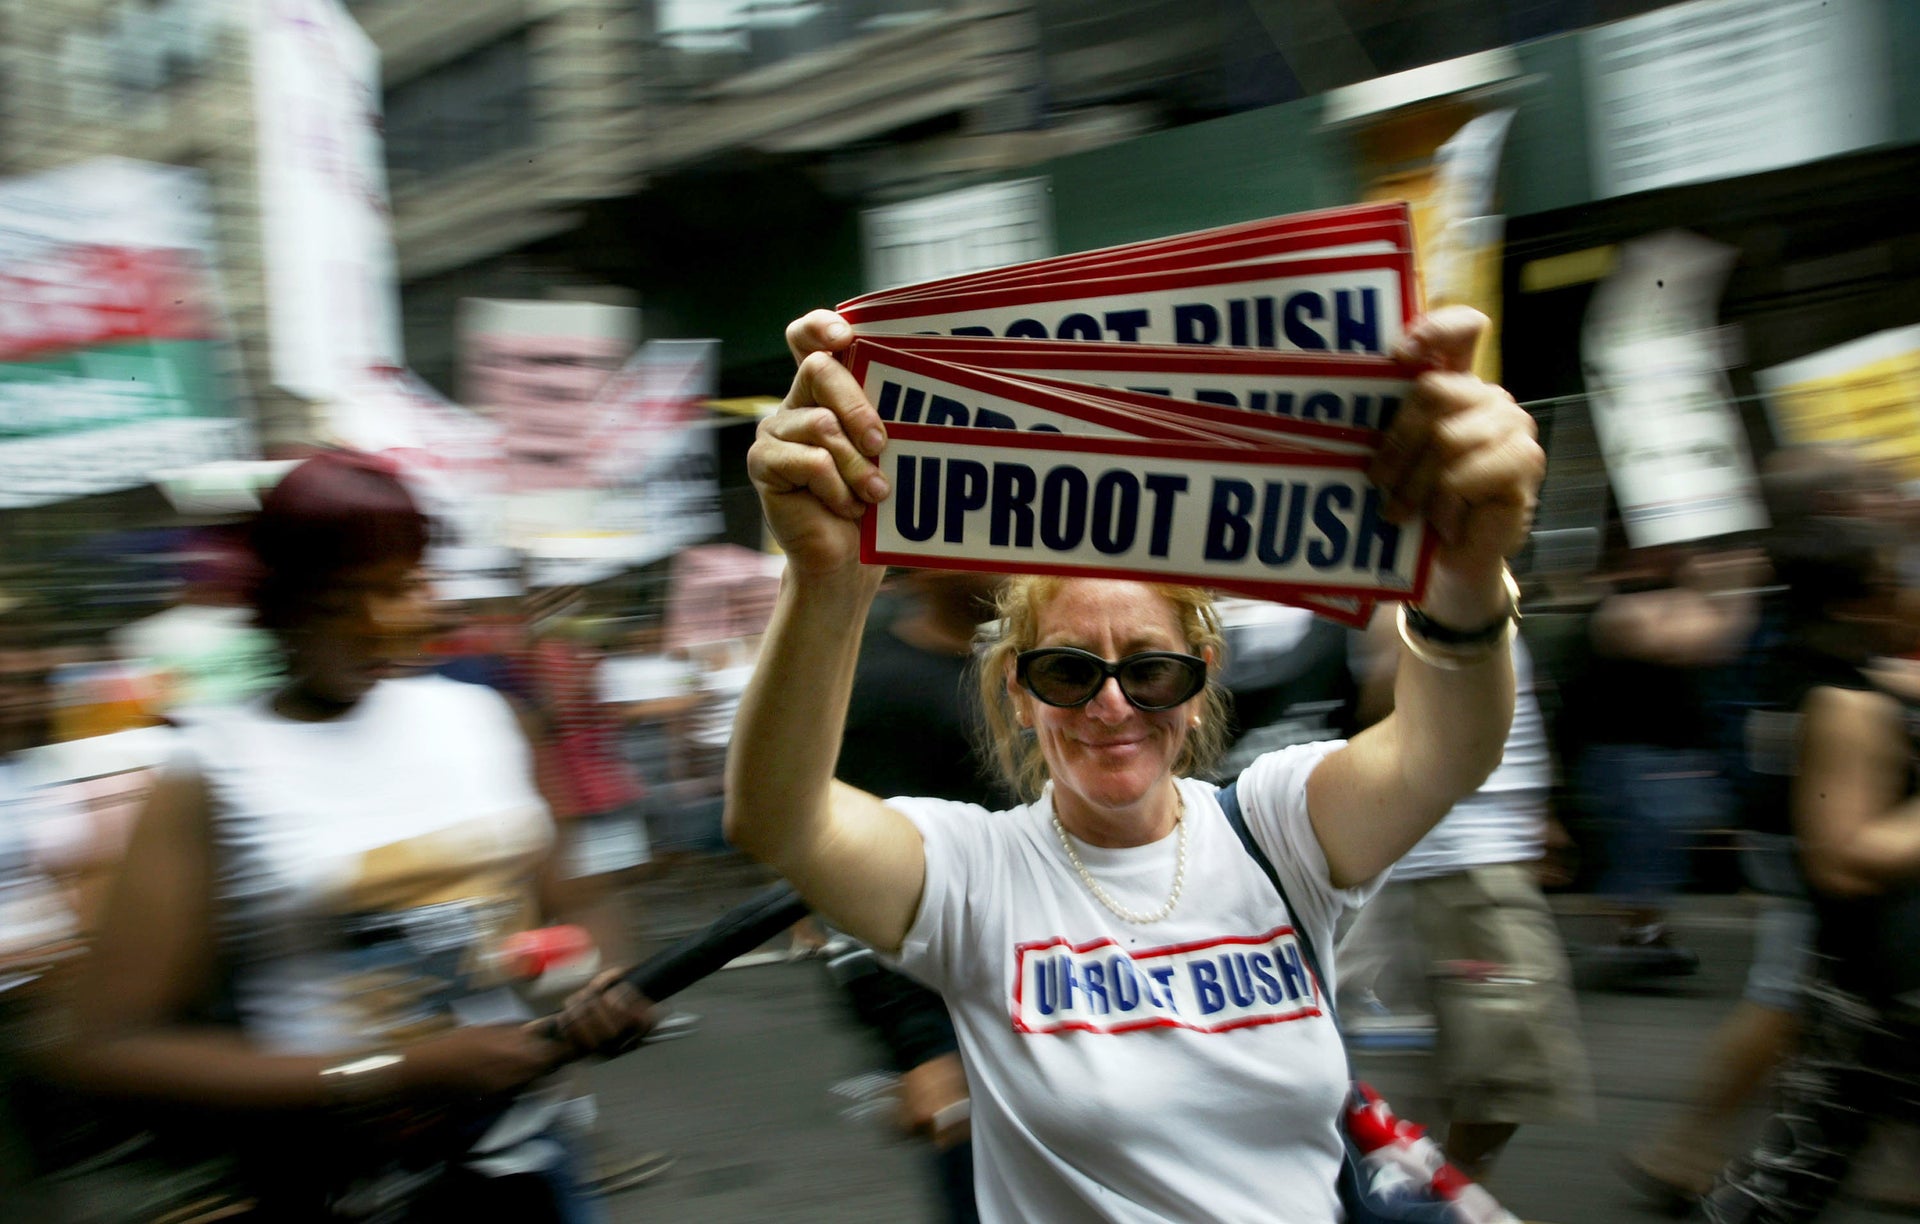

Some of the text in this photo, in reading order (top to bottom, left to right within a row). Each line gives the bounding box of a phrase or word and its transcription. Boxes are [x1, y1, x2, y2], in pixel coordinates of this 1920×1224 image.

[894, 454, 1401, 573] UPROOT BUSH
[1186, 942, 1311, 1015] BUSH
